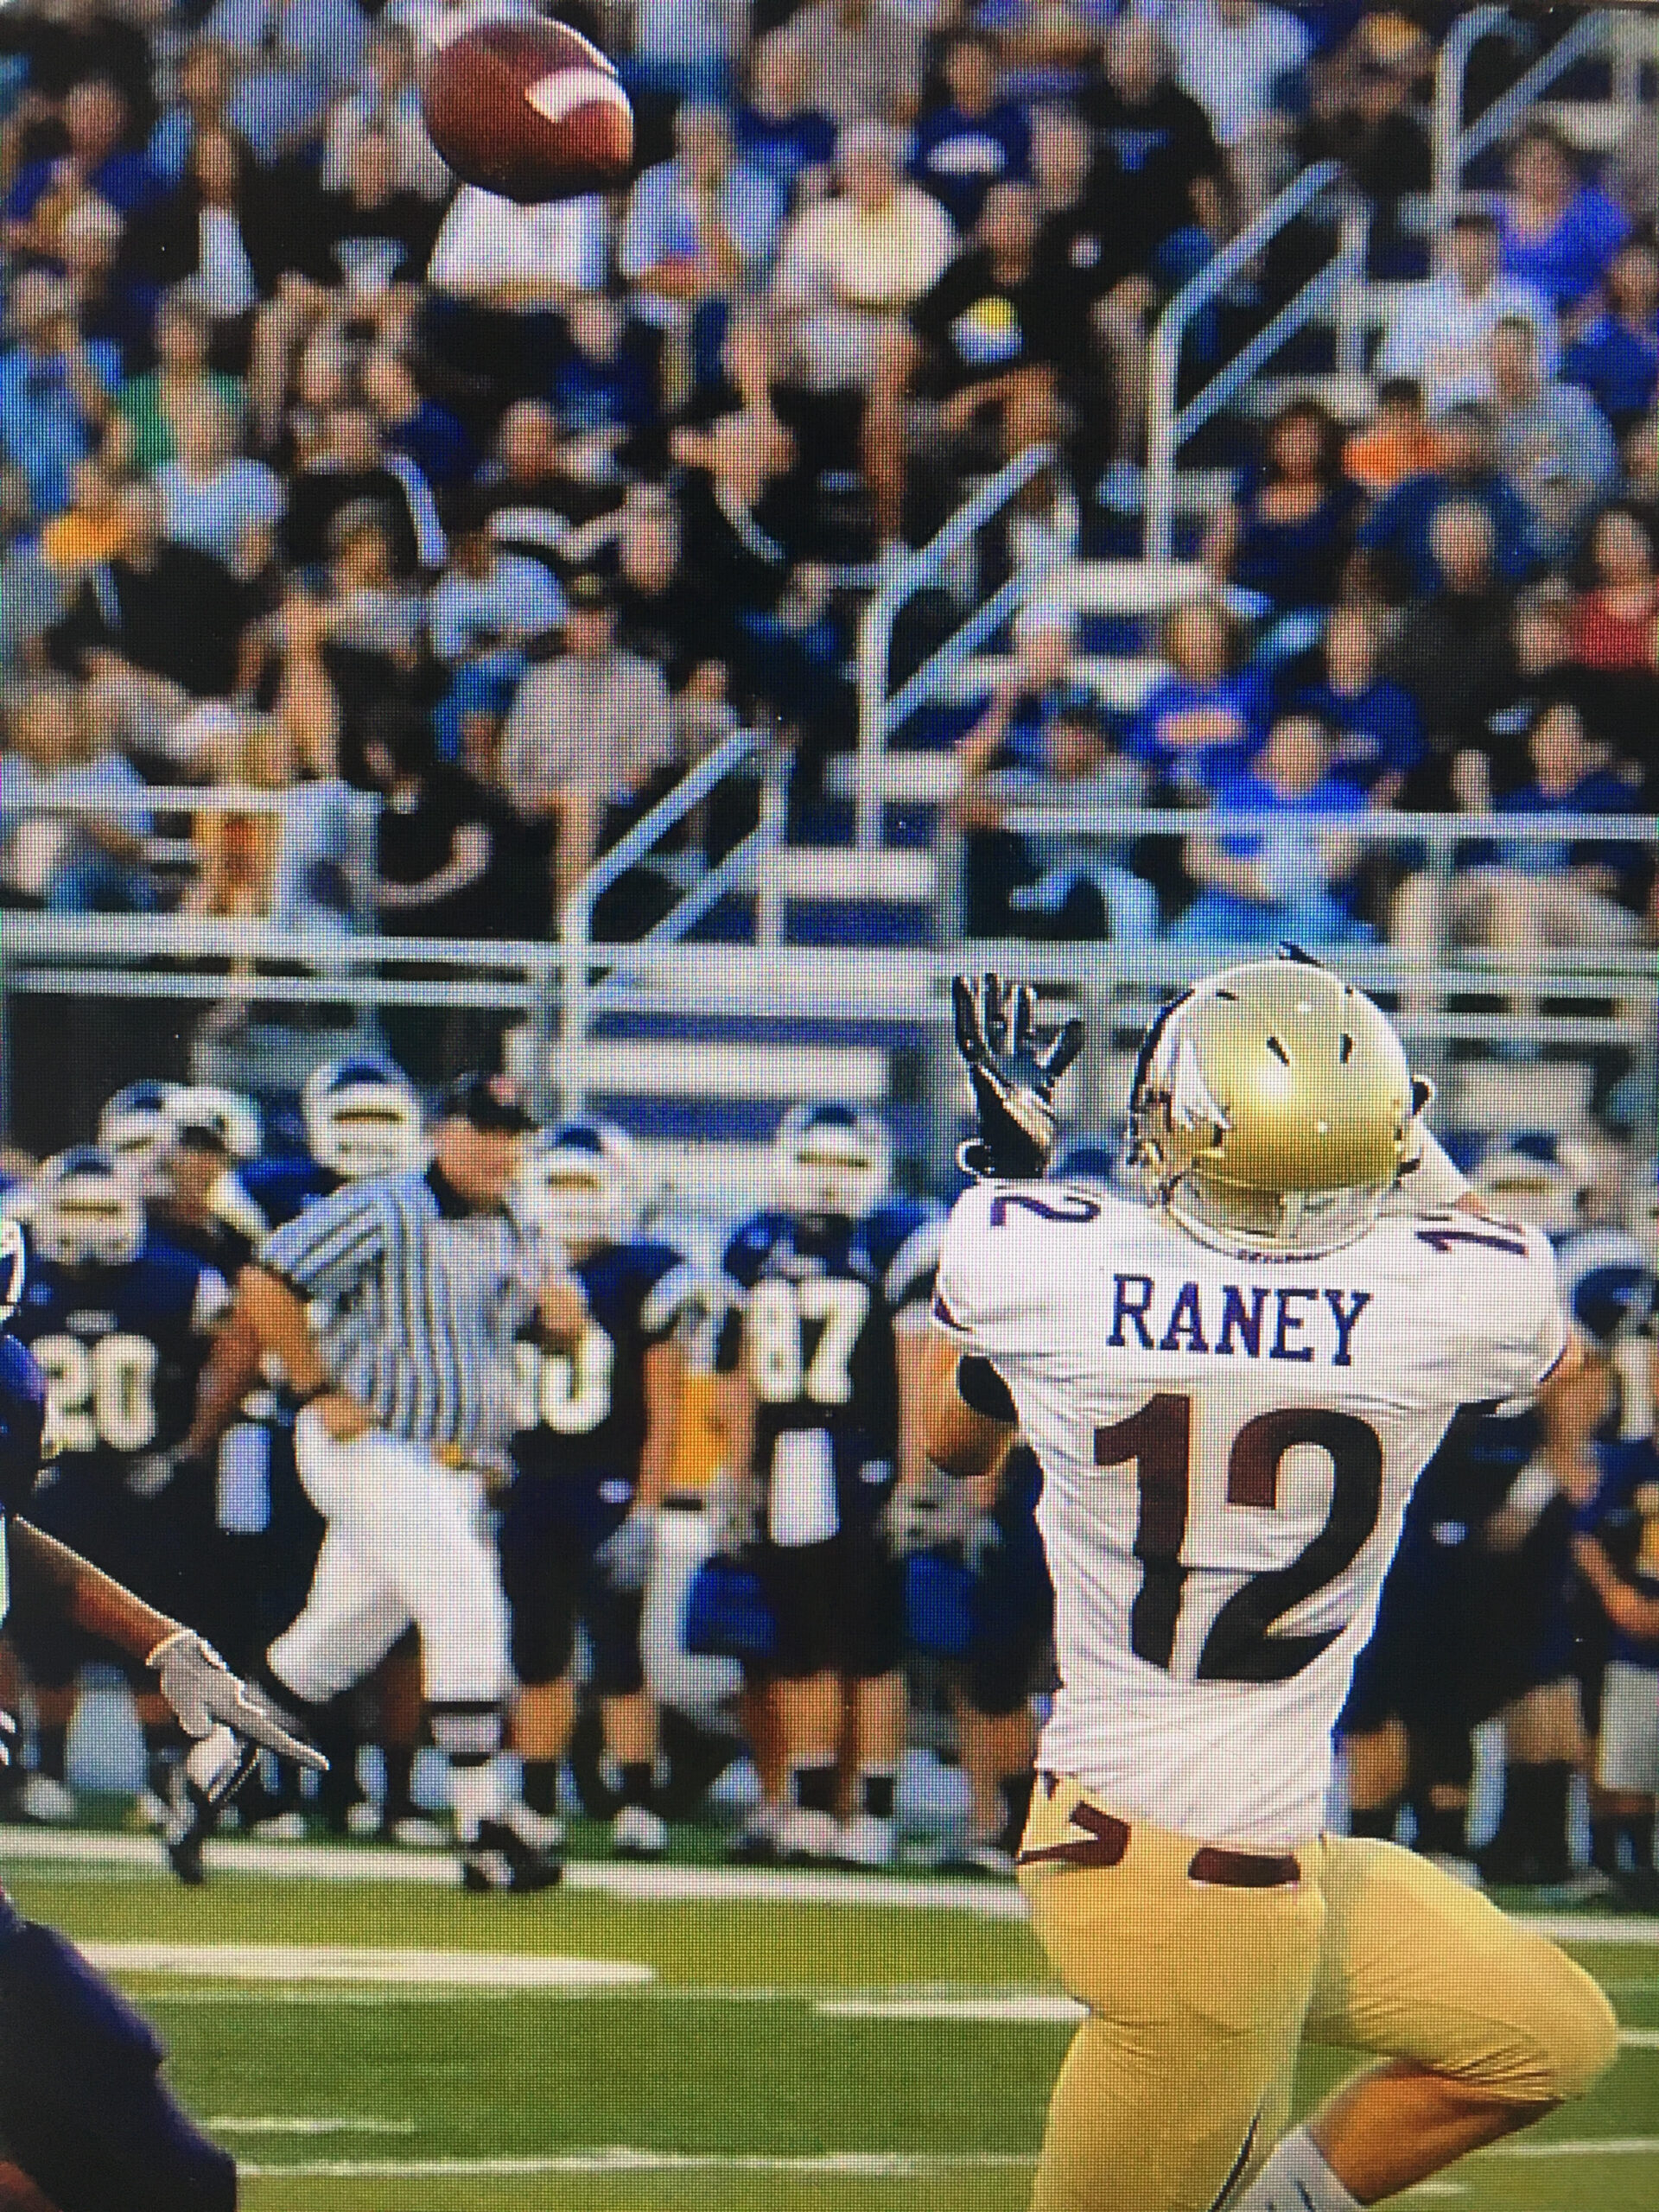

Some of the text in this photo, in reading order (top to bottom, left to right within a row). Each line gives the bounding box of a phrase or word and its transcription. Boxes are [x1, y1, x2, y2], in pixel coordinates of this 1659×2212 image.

[1106, 1274, 1372, 1366] RANEY
[29, 1333, 159, 1453] 20
[1094, 1393, 1383, 1681] 12
